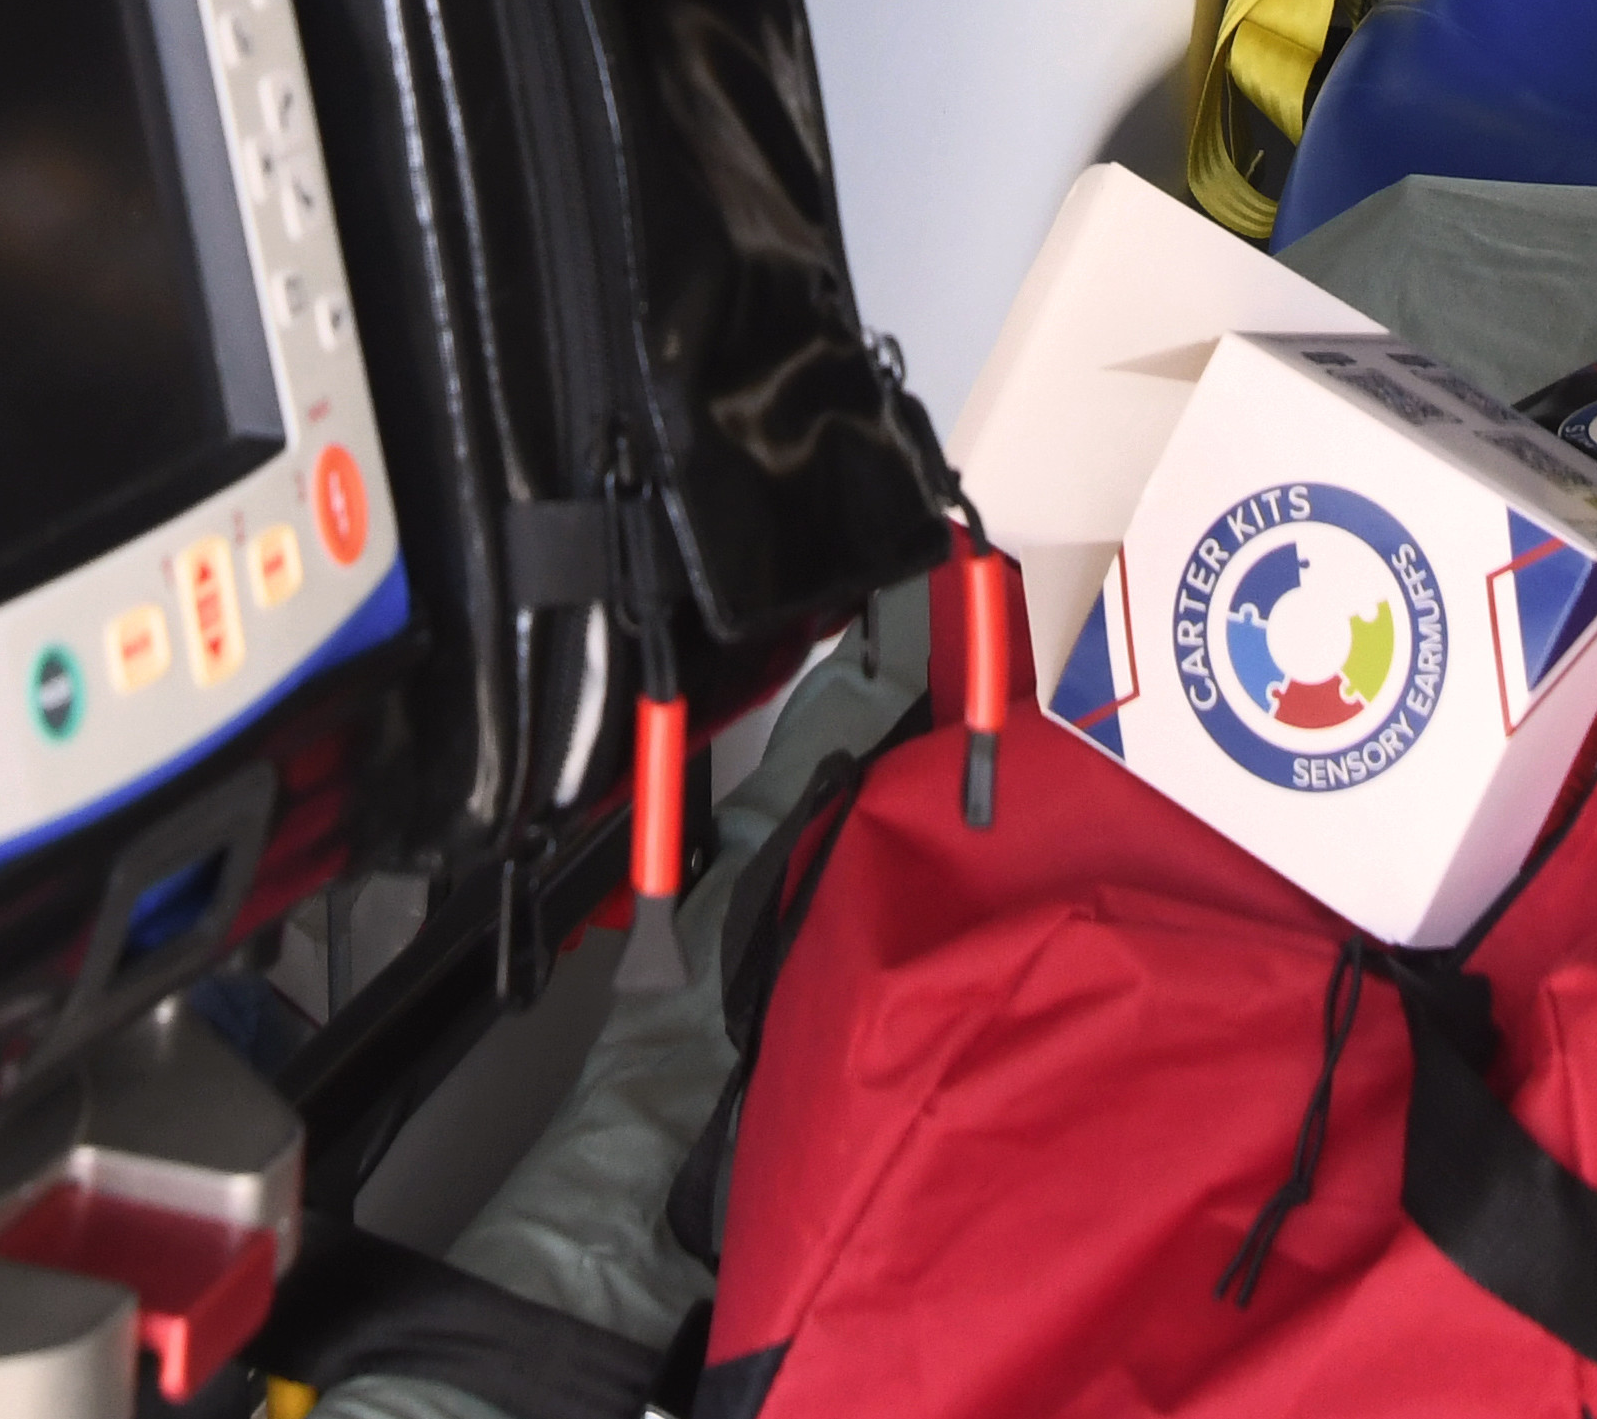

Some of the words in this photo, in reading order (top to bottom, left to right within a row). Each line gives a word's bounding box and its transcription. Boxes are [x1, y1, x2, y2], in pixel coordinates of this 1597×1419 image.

[1176, 536, 1230, 712] CARTER
[1225, 484, 1312, 544] KITS
[1292, 709, 1416, 791] SENSORY
[1390, 542, 1444, 718] EARMUFFS
